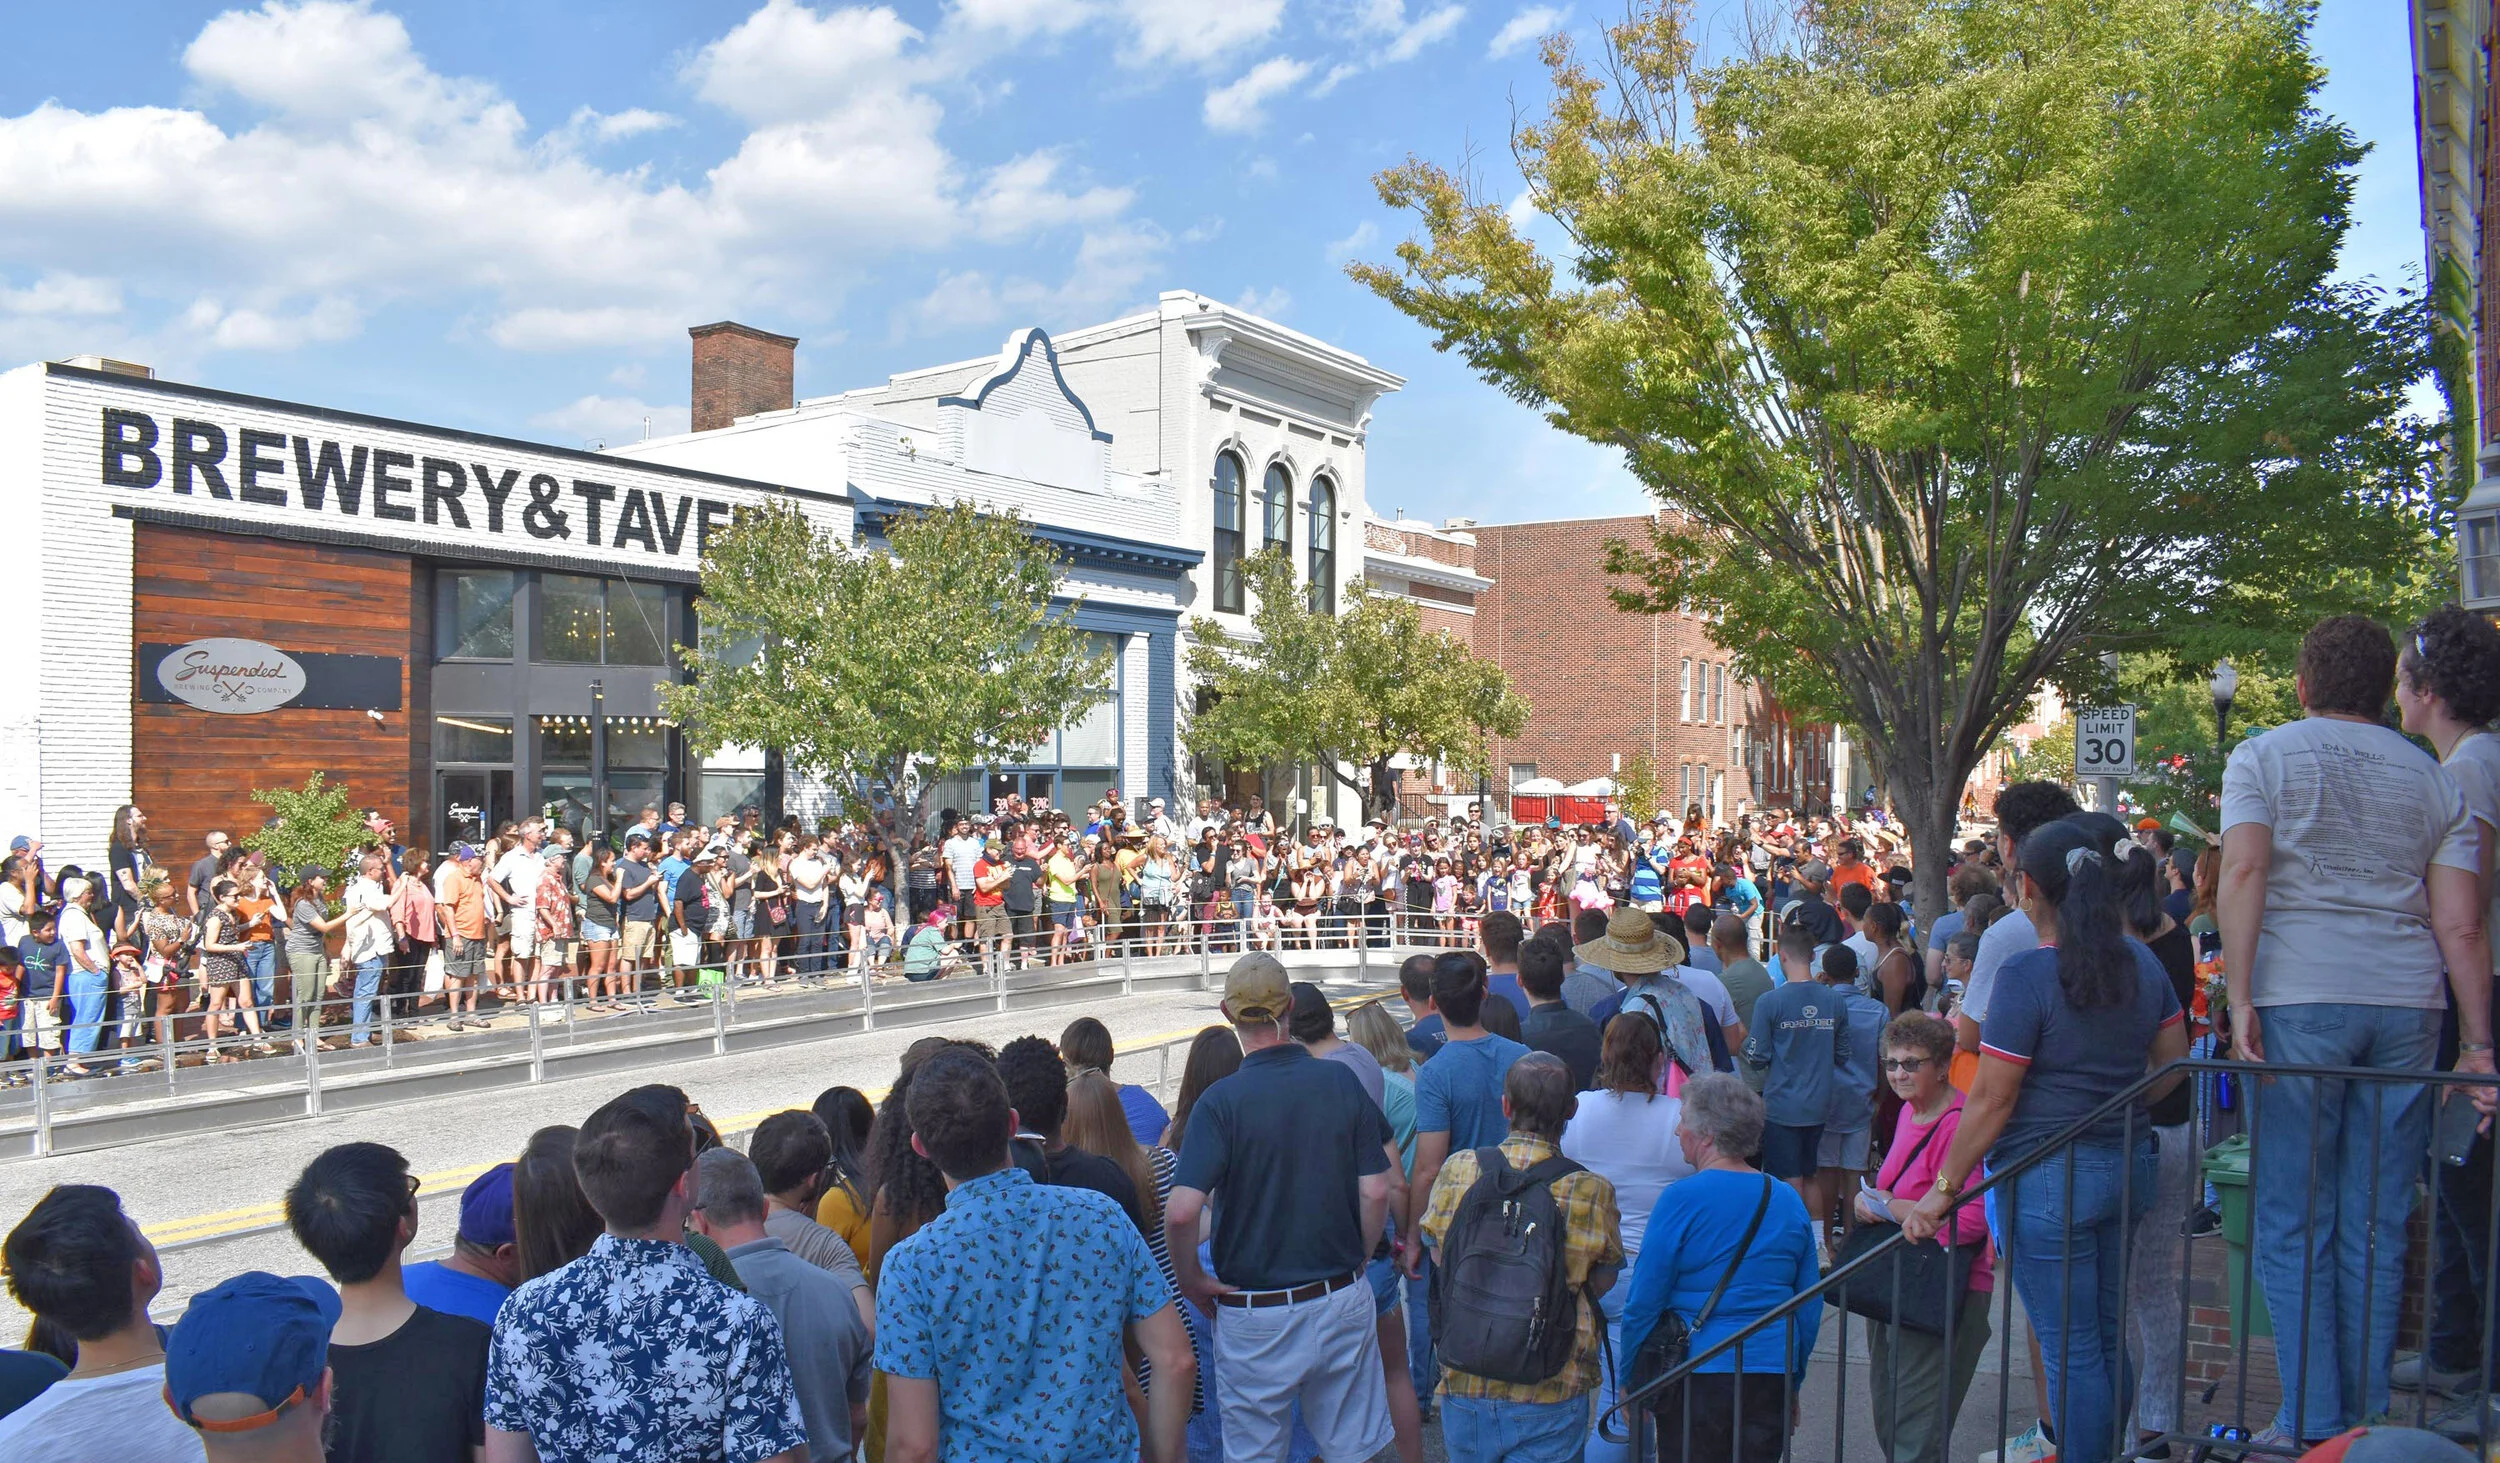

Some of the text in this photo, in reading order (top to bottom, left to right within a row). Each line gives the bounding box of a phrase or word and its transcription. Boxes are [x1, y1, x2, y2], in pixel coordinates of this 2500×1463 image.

[175, 650, 287, 682] Suspended
[2082, 709, 2130, 720] SPEED
[2086, 723, 2125, 734] LIMIT
[2084, 738, 2126, 765] 30
